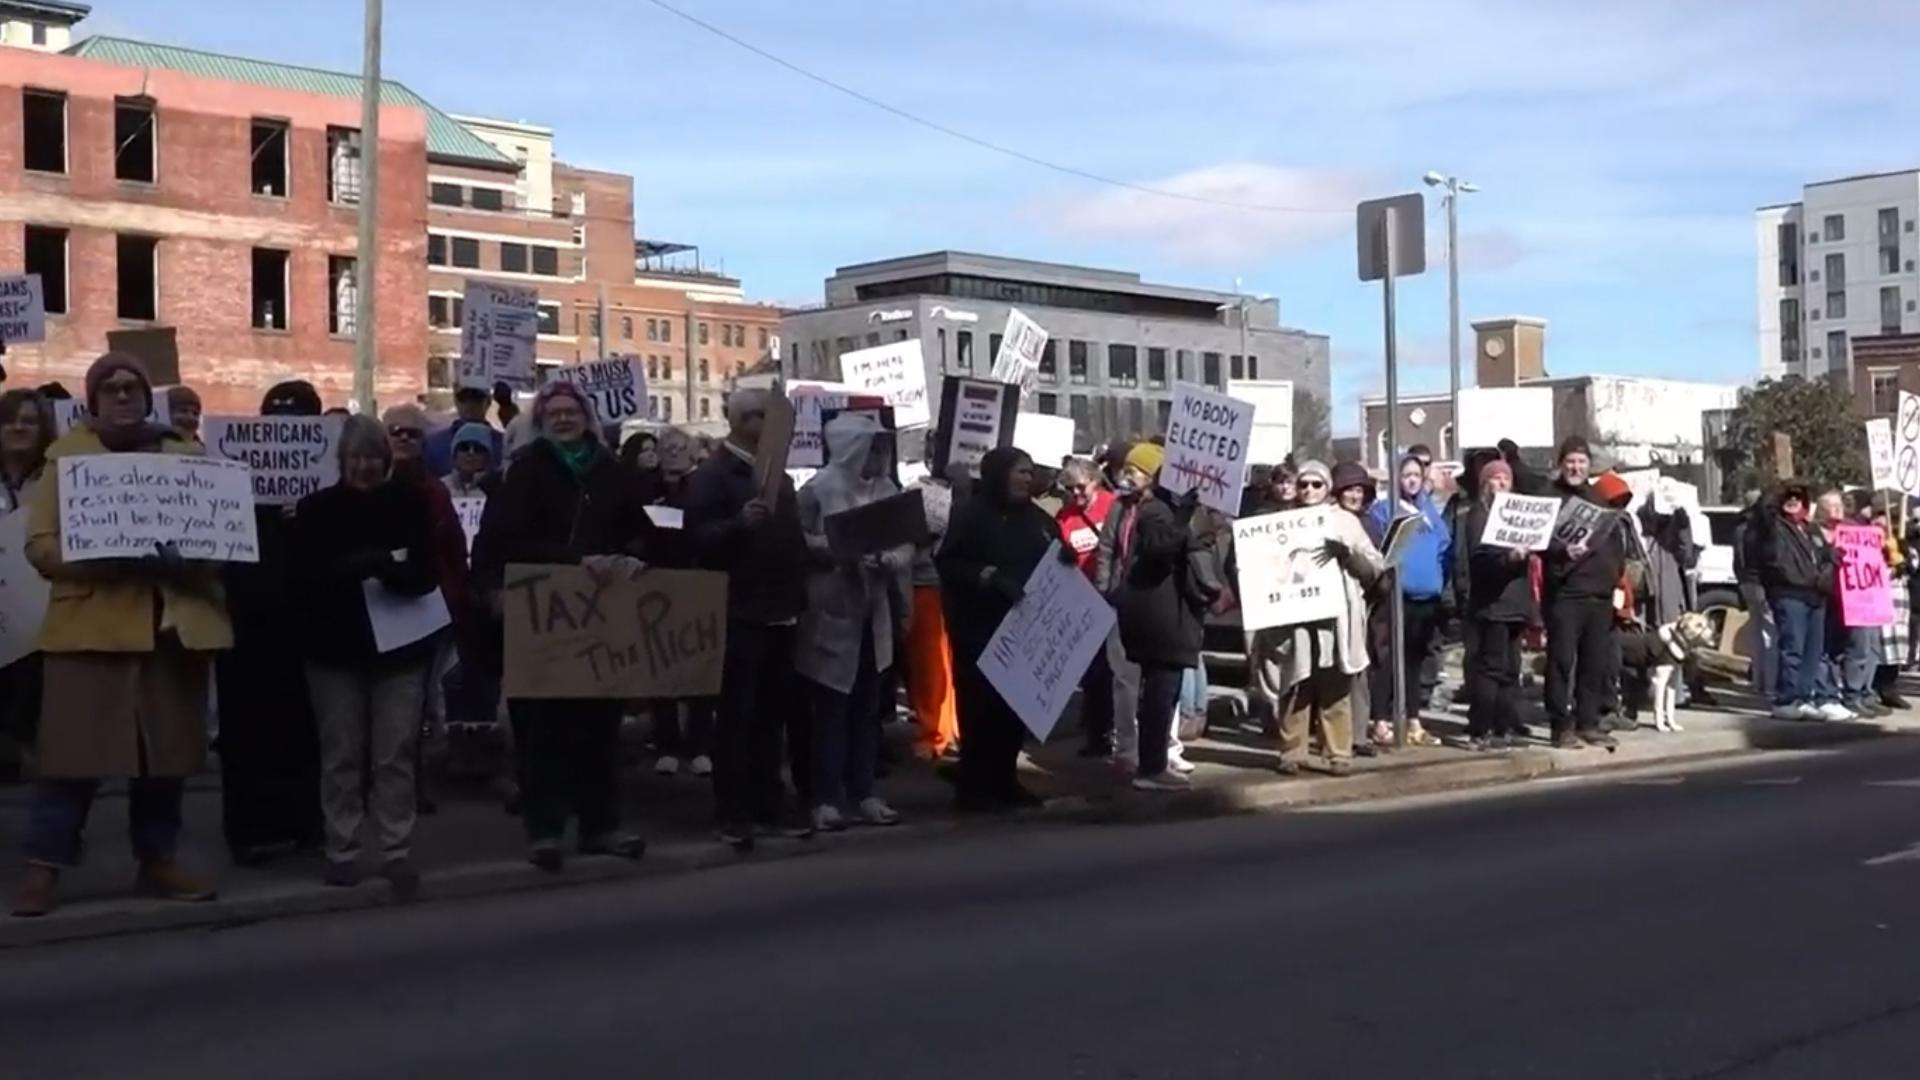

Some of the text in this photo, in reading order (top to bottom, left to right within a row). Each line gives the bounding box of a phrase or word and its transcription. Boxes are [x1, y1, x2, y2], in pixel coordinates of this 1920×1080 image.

[590, 359, 631, 384] MUSK
[606, 387, 637, 418] US
[1183, 395, 1239, 430] NOBODY
[225, 422, 323, 444] AMERICANS
[1169, 421, 1240, 461] ELECTED
[240, 449, 310, 470] AGAINST
[66, 462, 215, 489] The alien who
[251, 475, 321, 496] IGARCHY
[68, 491, 241, 518] resides with you
[68, 510, 246, 534] shall be to you as
[68, 533, 98, 551] the
[104, 533, 158, 549] citizen
[224, 540, 255, 560] you
[1843, 562, 1884, 591] ELON
[506, 573, 607, 634] TAX
